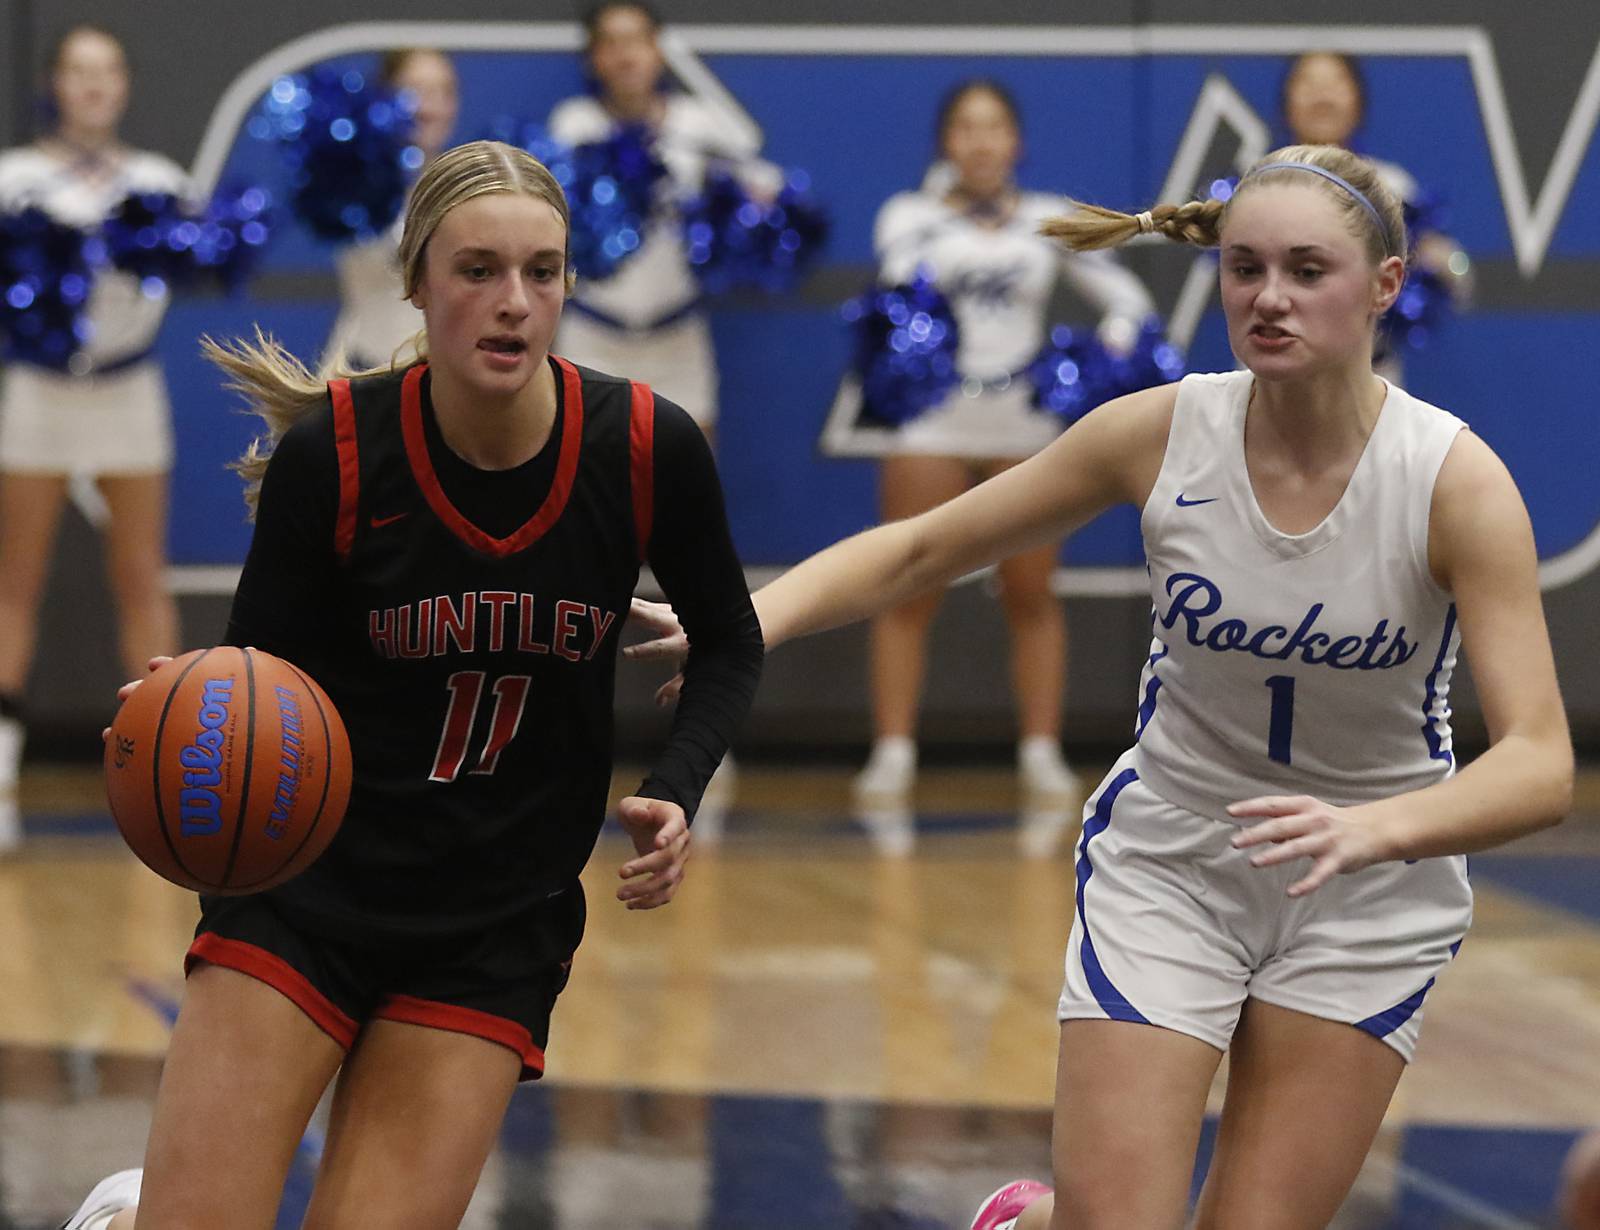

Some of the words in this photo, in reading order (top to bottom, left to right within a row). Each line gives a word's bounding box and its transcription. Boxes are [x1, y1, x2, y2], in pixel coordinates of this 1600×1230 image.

[369, 590, 617, 662] HUNTLEY
[1159, 572, 1418, 671] Rockets
[179, 678, 235, 839] Wilson
[427, 670, 532, 783] 11
[1264, 675, 1296, 766] 1
